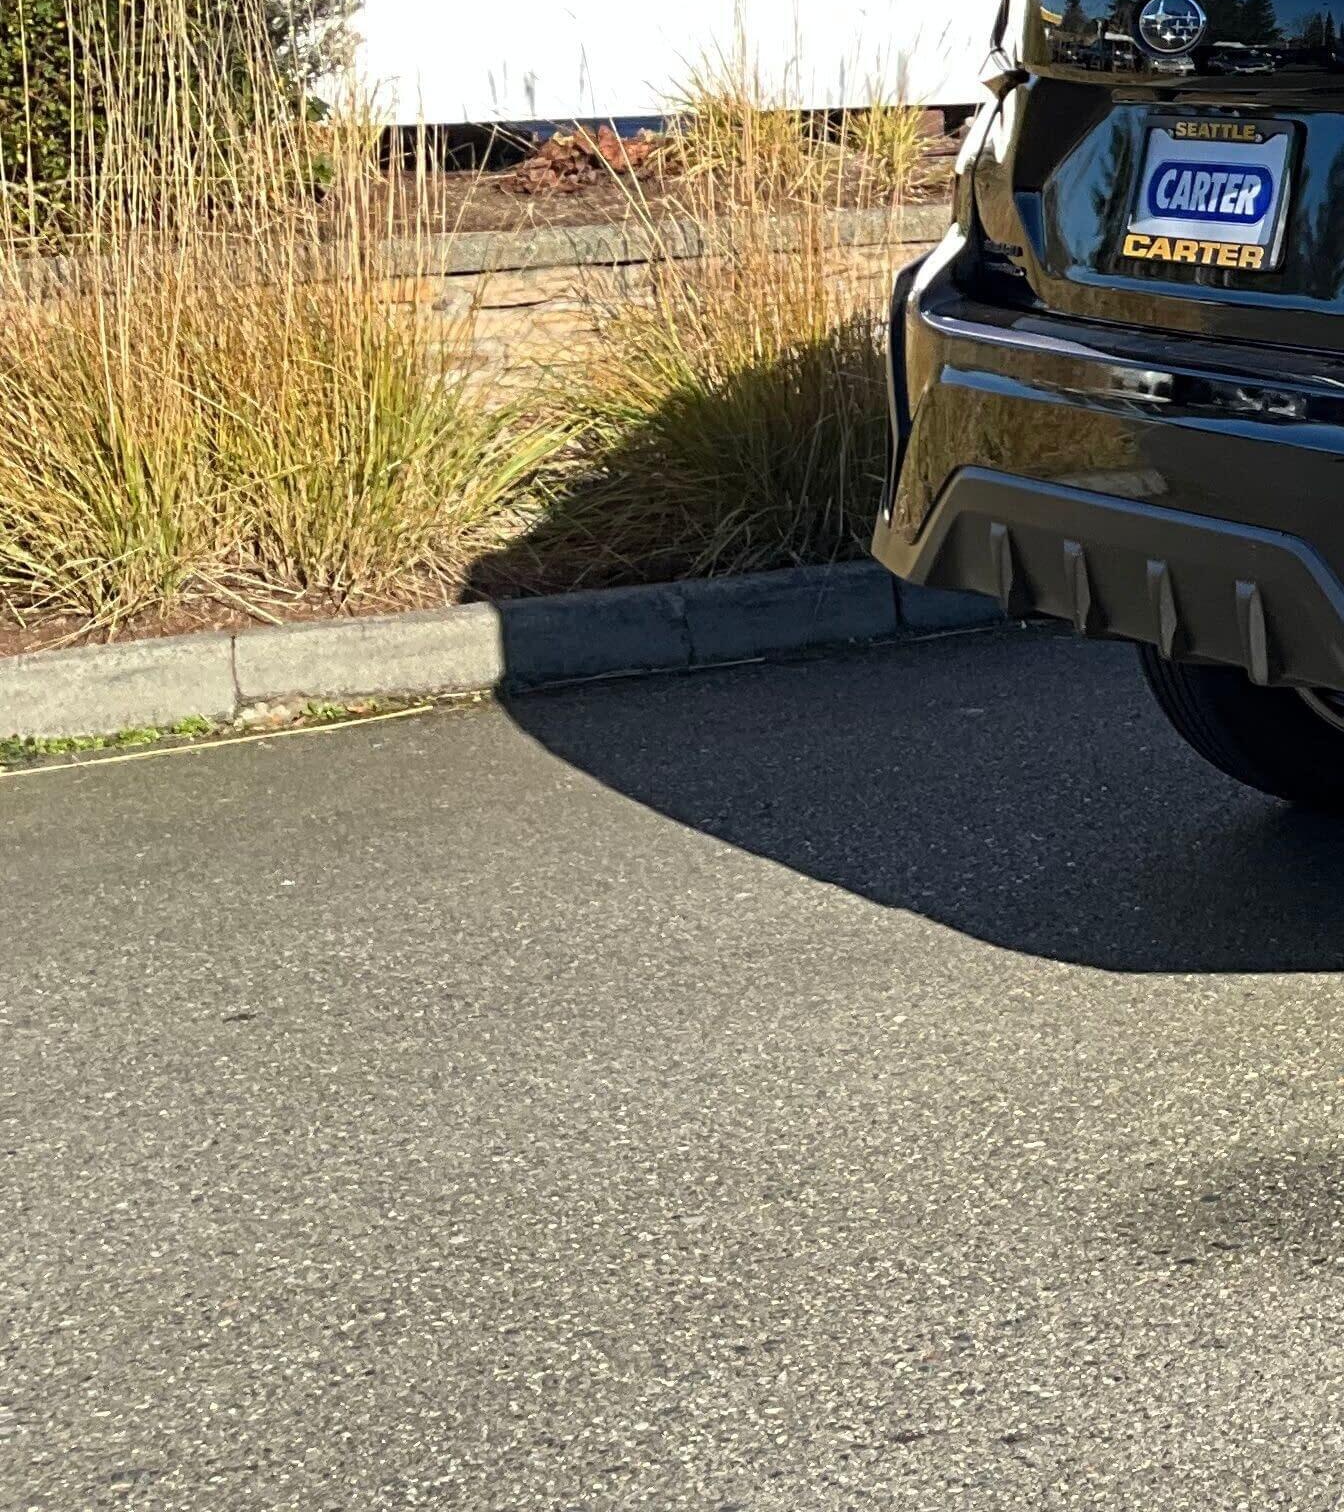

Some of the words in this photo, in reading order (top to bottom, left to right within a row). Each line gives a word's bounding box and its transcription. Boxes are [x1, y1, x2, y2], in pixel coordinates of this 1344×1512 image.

[1175, 121, 1256, 140] SEATTLE
[1155, 168, 1262, 215] CARTER
[1122, 234, 1264, 269] CARTER
